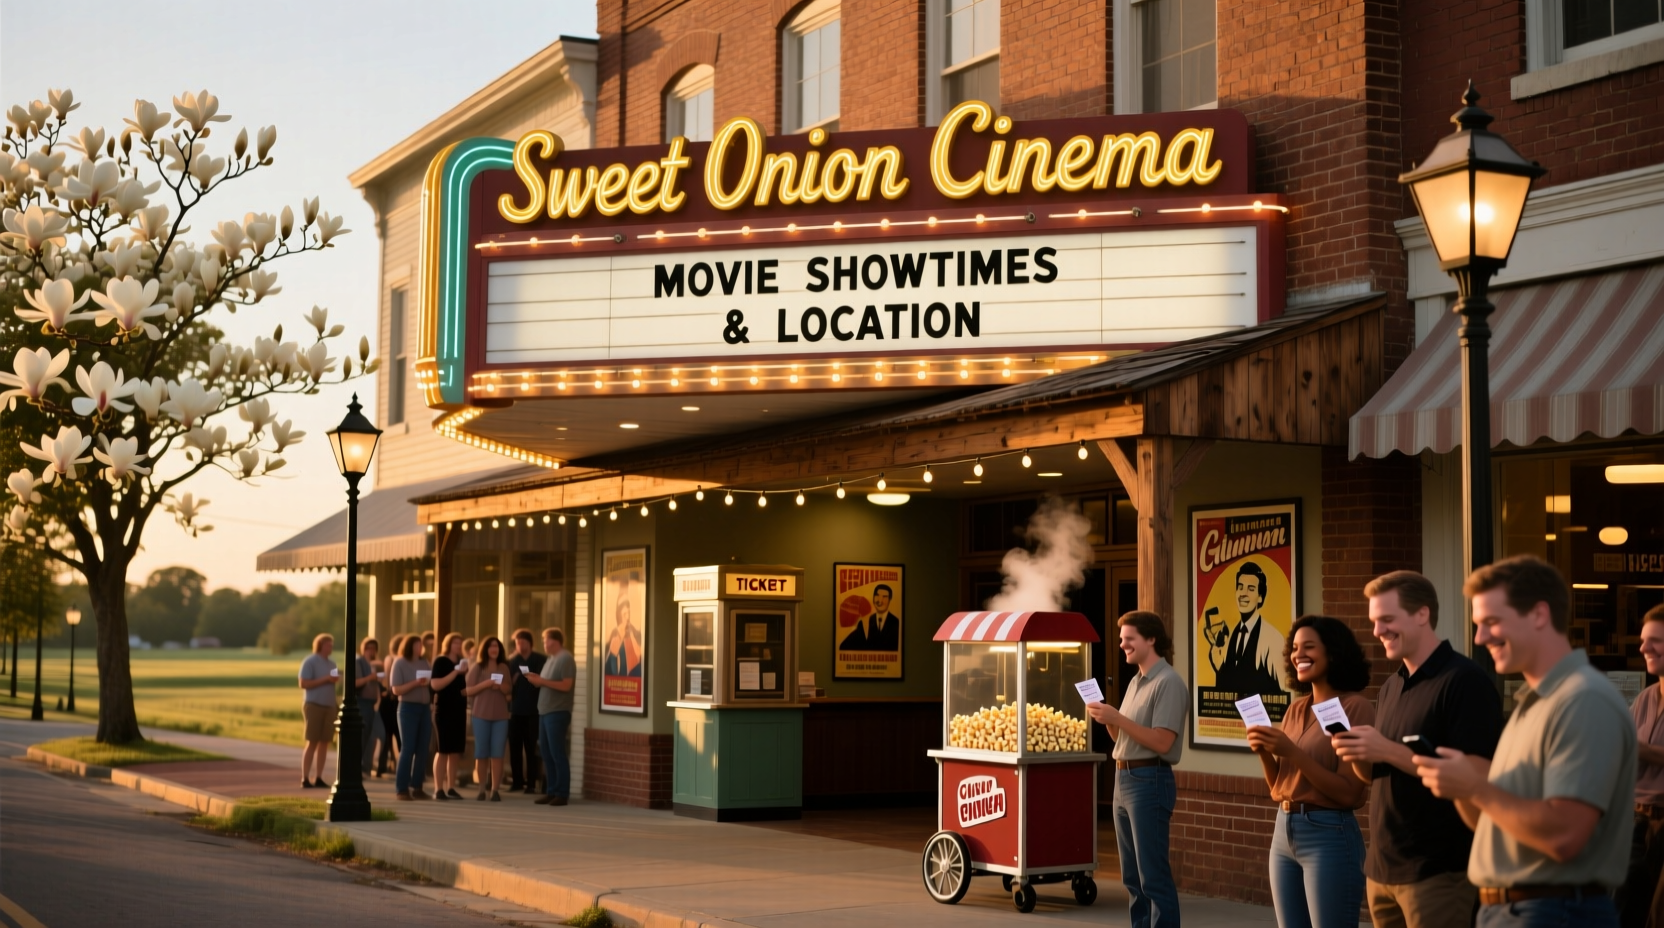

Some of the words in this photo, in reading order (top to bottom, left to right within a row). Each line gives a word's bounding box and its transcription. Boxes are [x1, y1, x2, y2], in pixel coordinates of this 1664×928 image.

[498, 129, 692, 224] Sweet
[704, 116, 910, 210] Onion
[930, 100, 1222, 199] Cinema
[654, 259, 779, 298] MOVIE
[805, 246, 1059, 293] SHOWTIMES
[722, 309, 750, 345] &
[777, 301, 981, 343] LOCATION
[736, 577, 788, 593] TICKET
